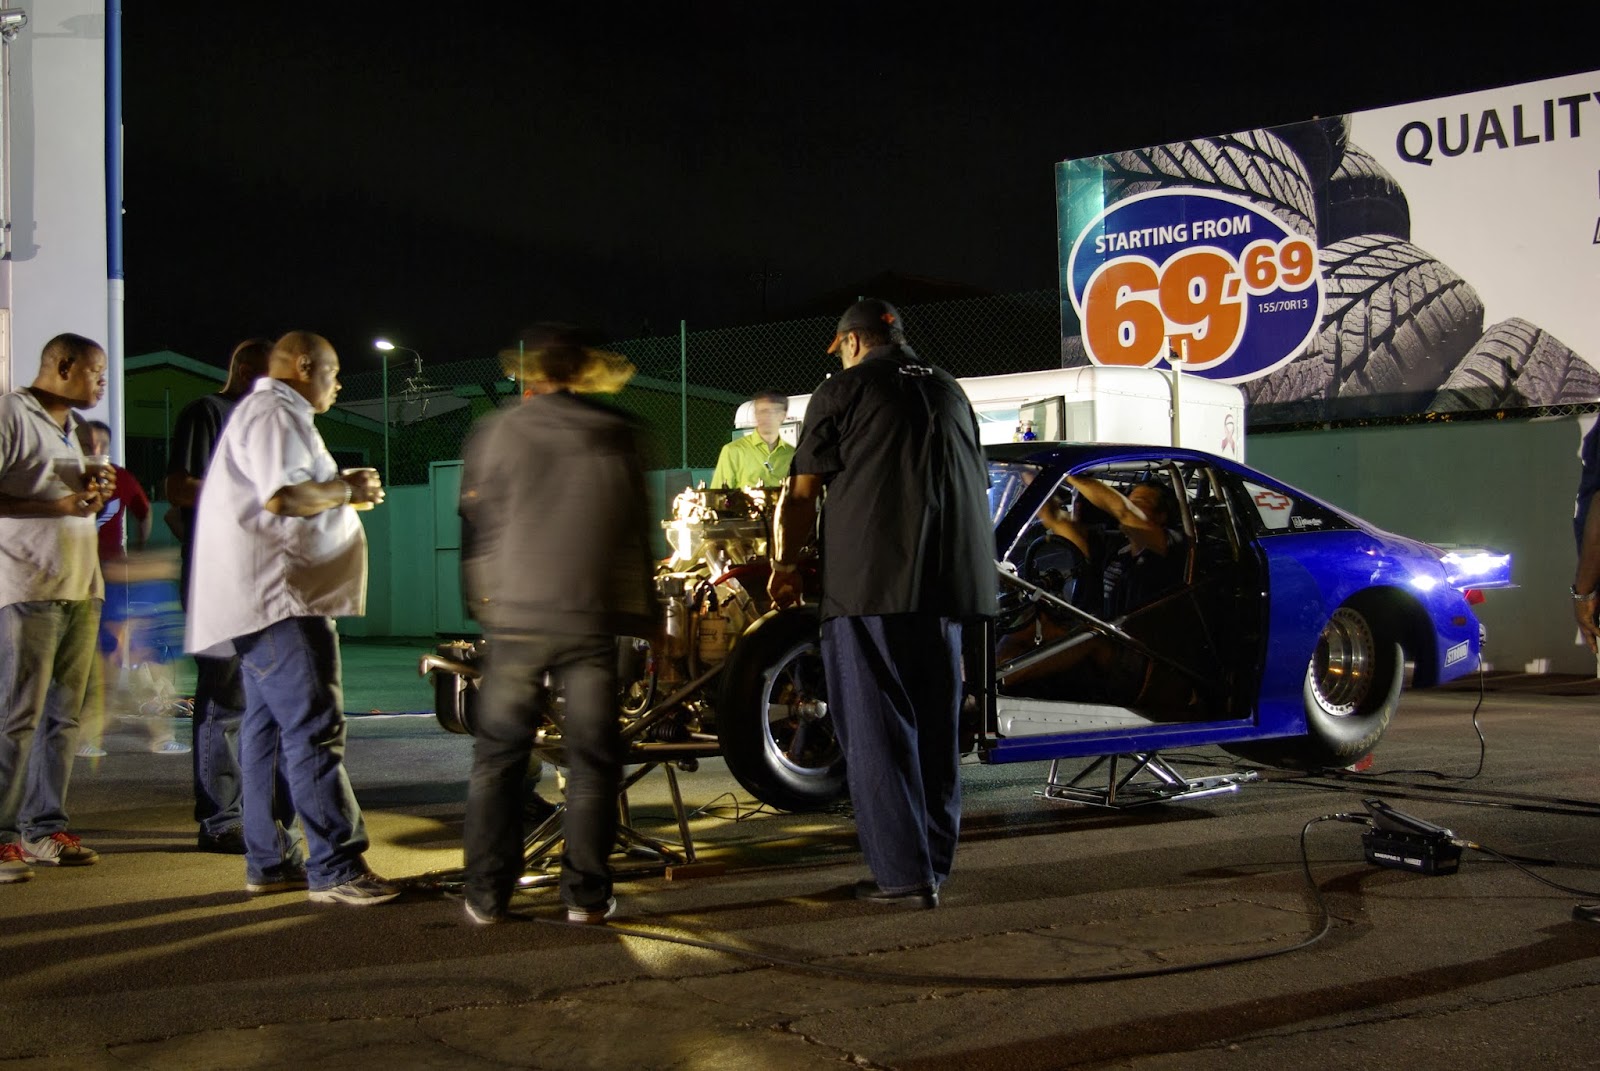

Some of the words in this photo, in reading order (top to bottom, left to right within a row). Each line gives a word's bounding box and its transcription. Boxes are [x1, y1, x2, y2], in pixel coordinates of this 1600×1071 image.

[1396, 91, 1600, 166] QUALIT
[1095, 223, 1187, 254] STARTING
[1192, 214, 1251, 241] FROM
[1258, 299, 1308, 314] 155/70R13
